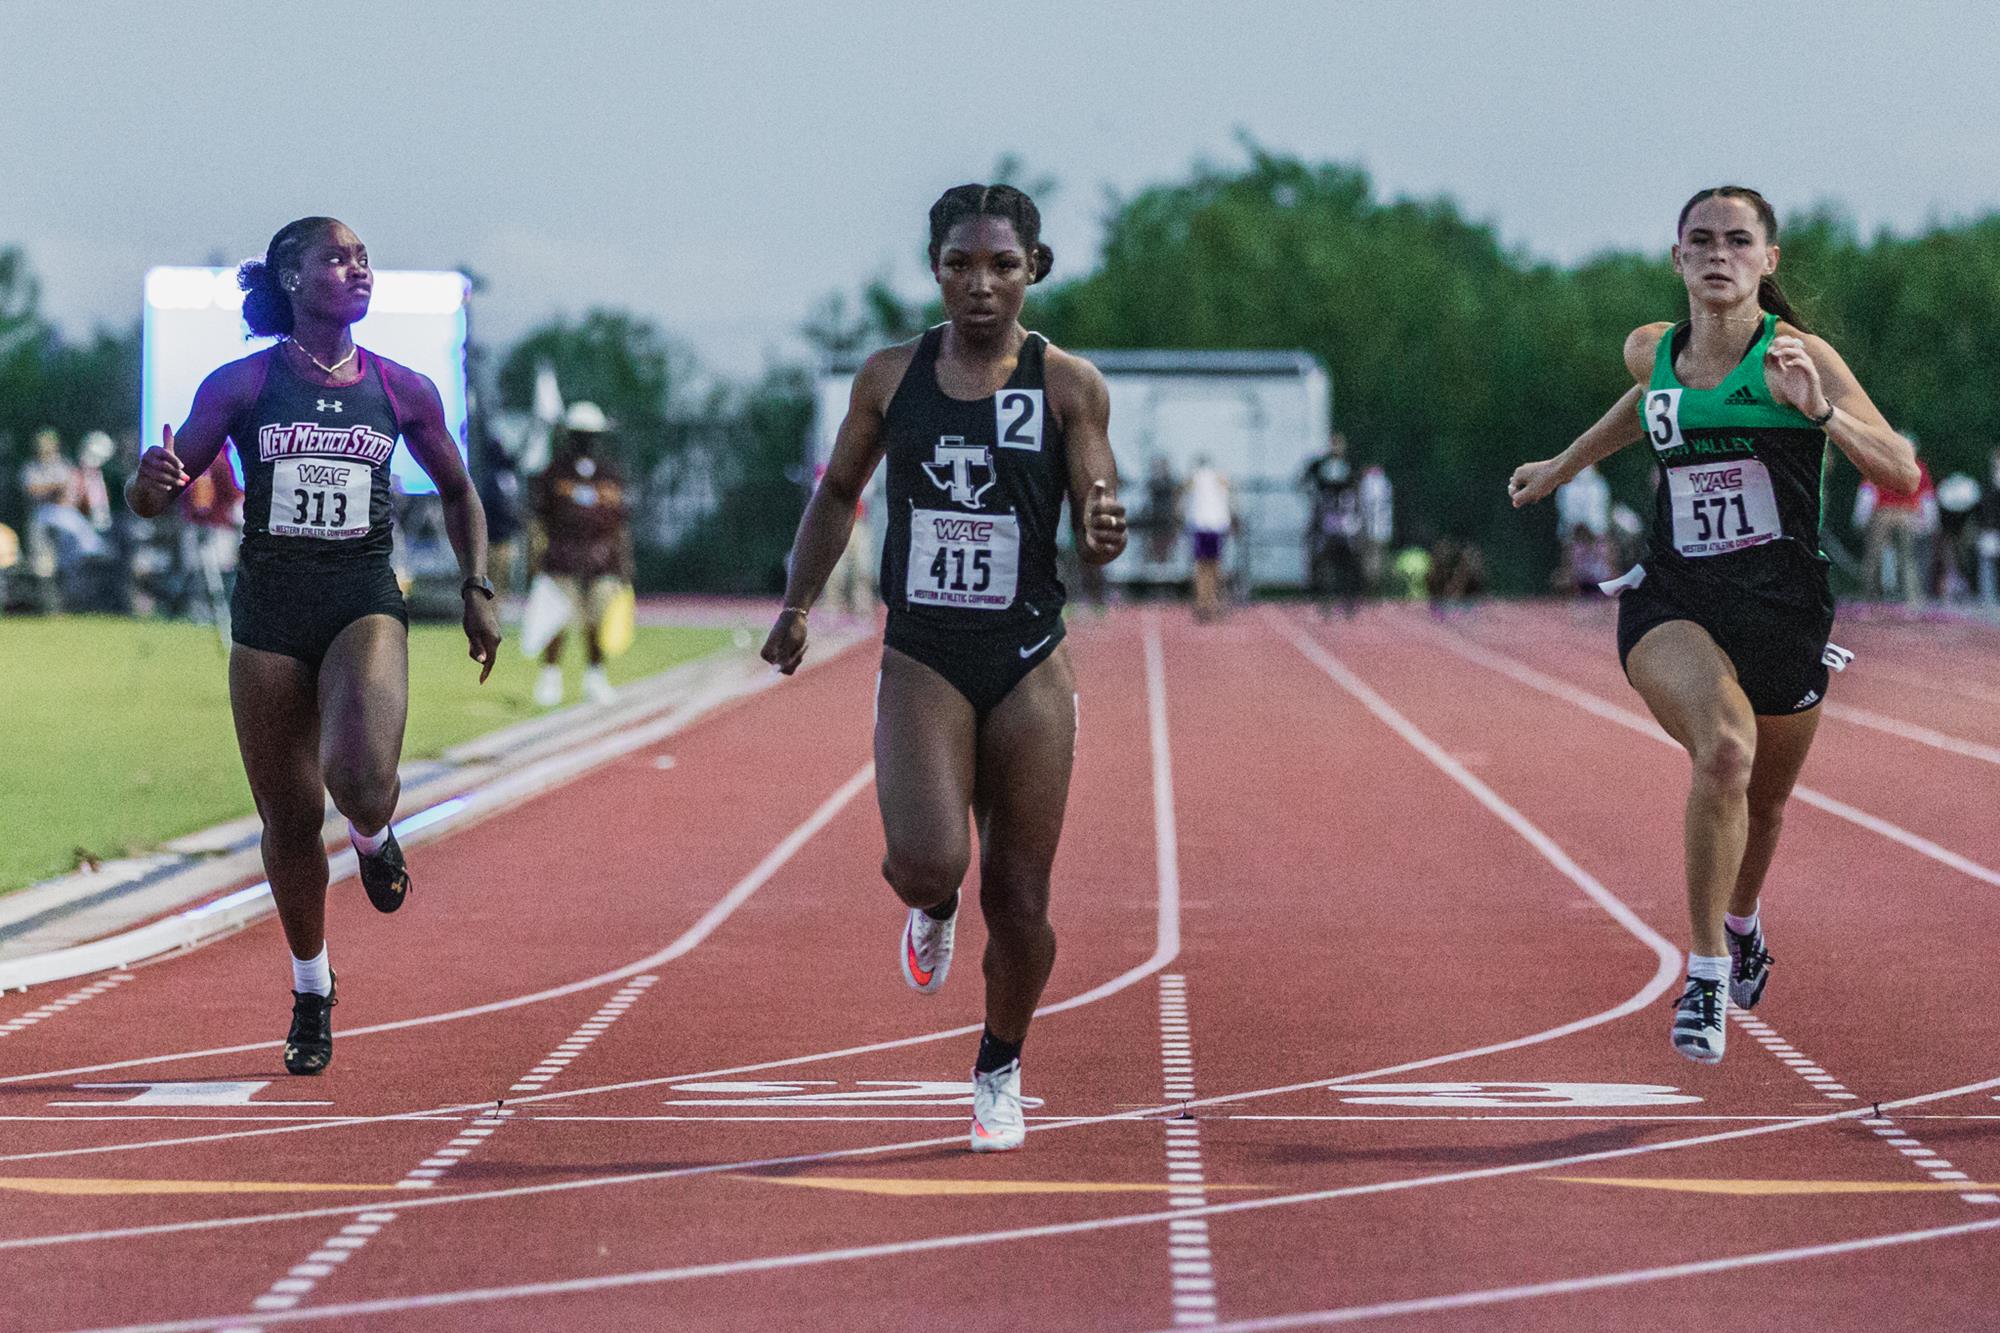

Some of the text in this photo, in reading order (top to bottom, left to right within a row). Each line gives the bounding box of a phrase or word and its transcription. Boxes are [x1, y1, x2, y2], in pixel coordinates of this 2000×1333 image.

[1001, 392, 1036, 446] 2
[1652, 392, 1673, 446] 3
[262, 426, 393, 462] NEW MEXICO STATE
[1689, 438, 1754, 454] VALLEY
[297, 464, 351, 486] WAC
[1689, 468, 1742, 493] WAC
[292, 488, 347, 527] 313
[1692, 493, 1755, 541] 571
[276, 525, 300, 534] WESTERN
[301, 527, 326, 537] ATHLETIC
[933, 518, 993, 542] WAC
[1682, 543, 1707, 553] WESTERN
[930, 546, 991, 592] 415
[914, 589, 1006, 605] WESTERN ATHLETIC CONFERENCE
